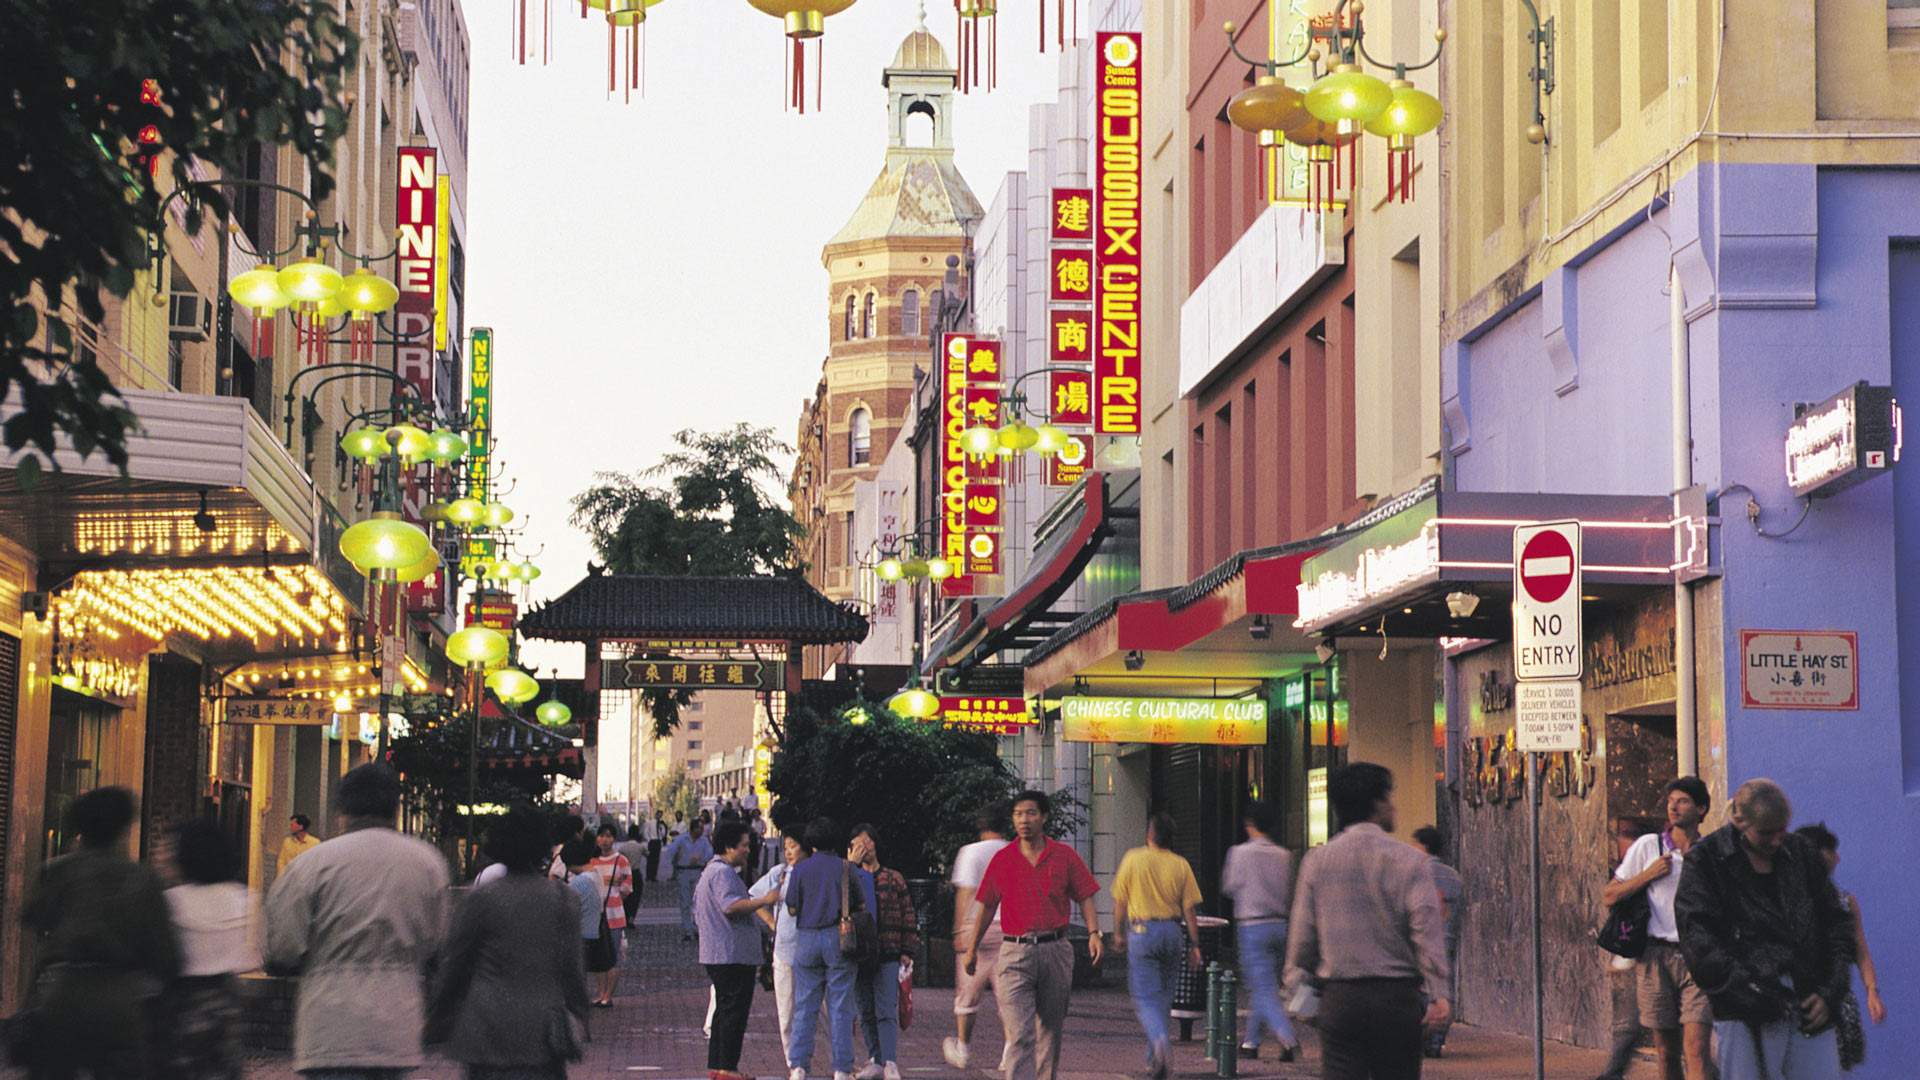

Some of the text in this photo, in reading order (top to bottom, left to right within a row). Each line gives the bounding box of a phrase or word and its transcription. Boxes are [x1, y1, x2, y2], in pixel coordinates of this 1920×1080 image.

[1104, 75, 1137, 86] Centre
[400, 154, 434, 293] NINE
[1102, 88, 1138, 433] SUSSEX CENTRE
[1055, 195, 1090, 415] 建德商場
[472, 339, 490, 388] NEW
[472, 397, 487, 447] TAI
[1533, 614, 1562, 637] NO
[1522, 645, 1576, 666] ENTRY
[1750, 653, 1797, 668] LITTLE
[1802, 655, 1828, 668] HAY
[1066, 700, 1265, 721] CHINESE CULTURAL CLUB
[1551, 711, 1577, 721] BETWEEN
